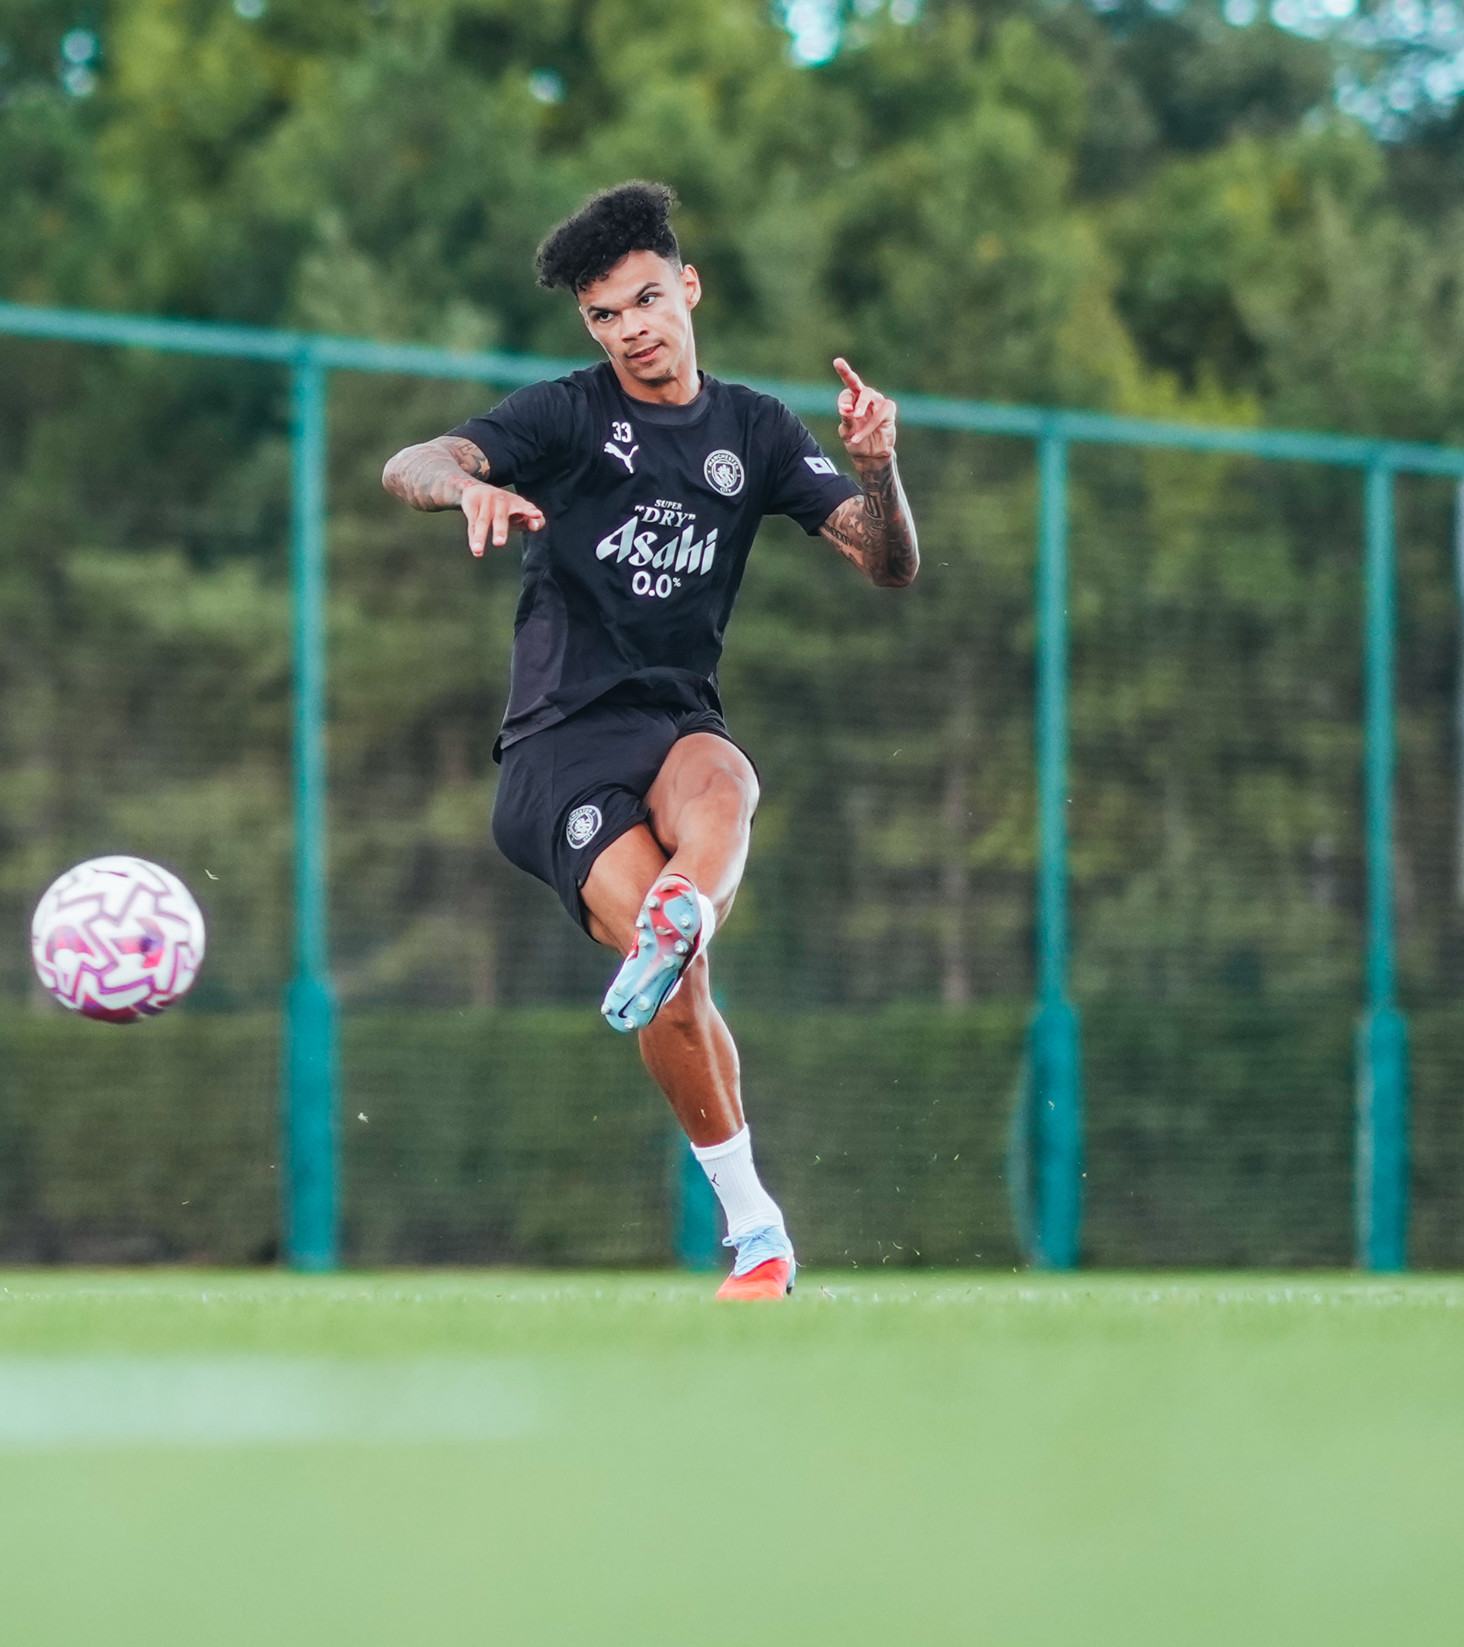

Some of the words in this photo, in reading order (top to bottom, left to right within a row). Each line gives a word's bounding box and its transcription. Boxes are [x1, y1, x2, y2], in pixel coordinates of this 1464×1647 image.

[612, 421, 632, 443] 33
[654, 499, 683, 511] SUPER
[595, 516, 719, 576] Asahi
[632, 570, 682, 599] 0.0%
